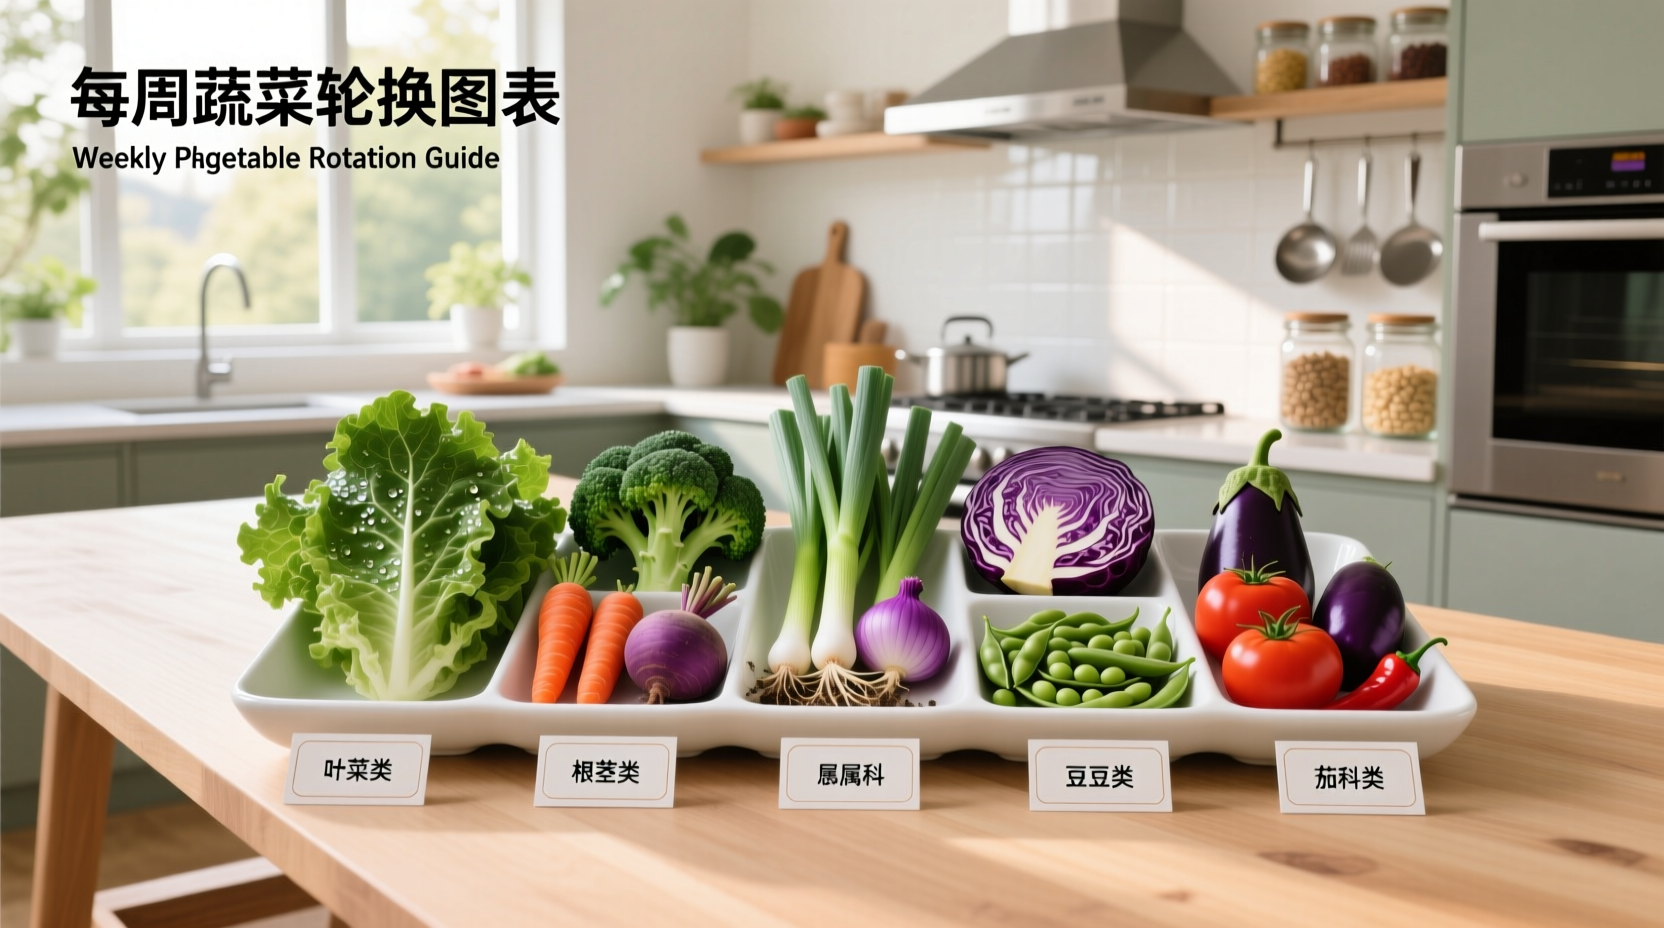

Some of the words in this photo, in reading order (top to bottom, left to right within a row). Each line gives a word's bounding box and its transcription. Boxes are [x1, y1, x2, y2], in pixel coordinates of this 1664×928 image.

[323, 757, 393, 782] 叶菜类
[1065, 764, 1134, 789] 豆豆类
[1314, 764, 1385, 790] 茄科类
